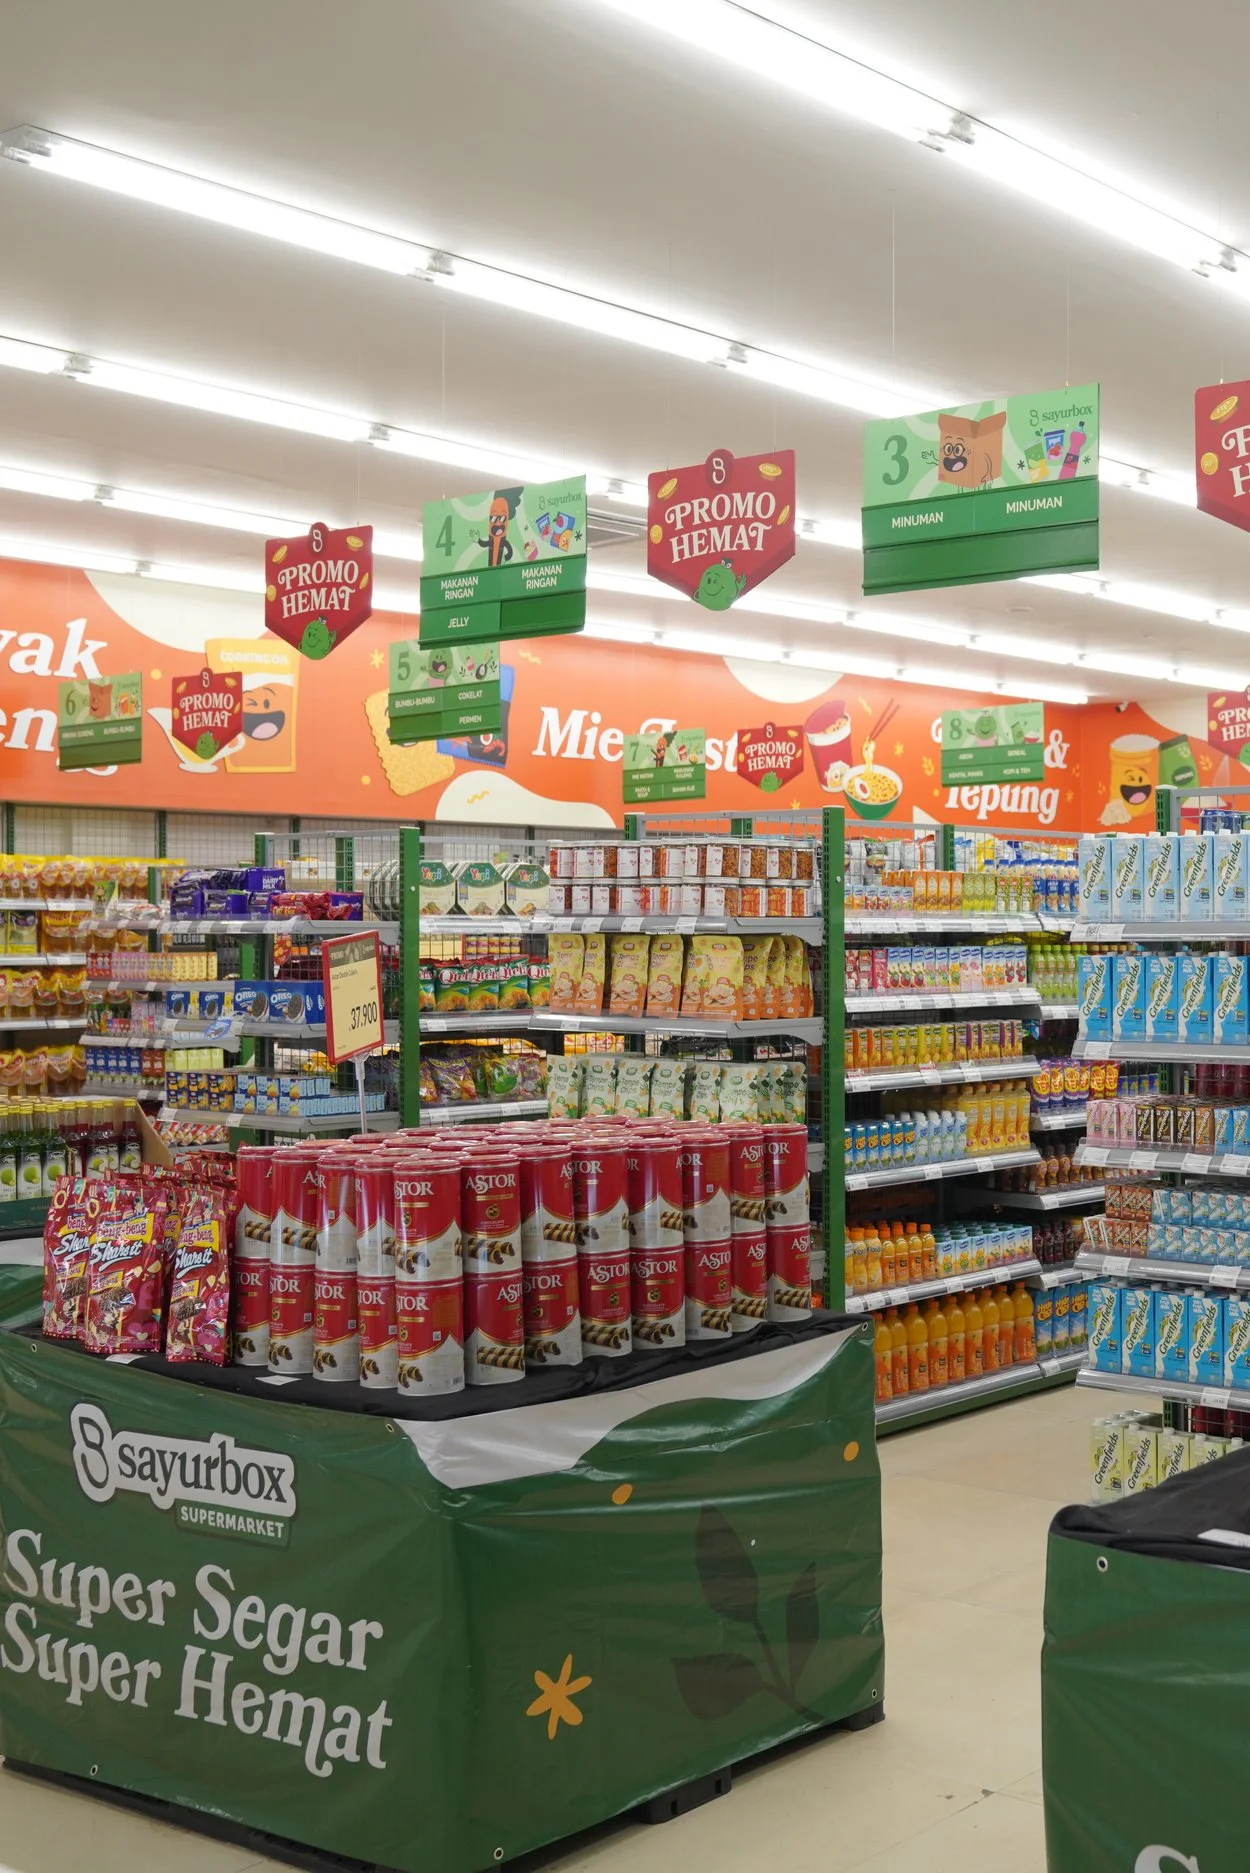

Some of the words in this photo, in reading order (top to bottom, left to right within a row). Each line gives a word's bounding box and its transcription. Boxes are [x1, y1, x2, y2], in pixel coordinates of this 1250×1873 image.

[1041, 404, 1093, 424] sayurbox
[882, 435, 910, 486] 3
[547, 492, 582, 507] sayurbox
[1006, 496, 1063, 514] MINUMAN
[665, 492, 776, 531] PROMO
[891, 512, 944, 529] MINUMAN
[435, 514, 456, 557] 4
[670, 522, 772, 563] HEMAT
[278, 560, 359, 590] PROMO
[521, 564, 562, 579] MAKANAN
[441, 576, 479, 590] MAKANAN
[526, 576, 557, 590] RINGAN
[281, 585, 355, 619] HEMAT
[444, 587, 474, 601] RINGAN
[447, 616, 469, 629] JELLY
[220, 651, 271, 664] COOKING
[397, 651, 411, 681] 5
[65, 690, 76, 715] 6
[180, 693, 234, 712] PROMO
[395, 696, 435, 709] BUMBU-BUMBU
[458, 690, 483, 701] COKELAT
[183, 710, 232, 731] HEMAT
[459, 714, 482, 724] PERMEN
[949, 717, 962, 741] 8
[532, 706, 624, 761] Mie
[629, 742, 639, 762] 7
[744, 742, 796, 756] PROMO
[1044, 729, 1070, 769] &
[748, 755, 794, 772] HEMAT
[235, 989, 258, 1003] OREO
[270, 991, 292, 1004] OREO
[351, 1001, 378, 1030] 37.900
[466, 1174, 516, 1193] ASTOR
[1093, 1294, 1116, 1348] Greenfields
[1095, 1432, 1118, 1485] Greenfields
[118, 1440, 287, 1502] sayurbox
[180, 1506, 284, 1539] SUPERMARKET
[4, 1529, 176, 1629] Super
[193, 1564, 383, 1676] Segar
[1, 1602, 161, 1708] Super
[174, 1644, 393, 1778] Hemat
